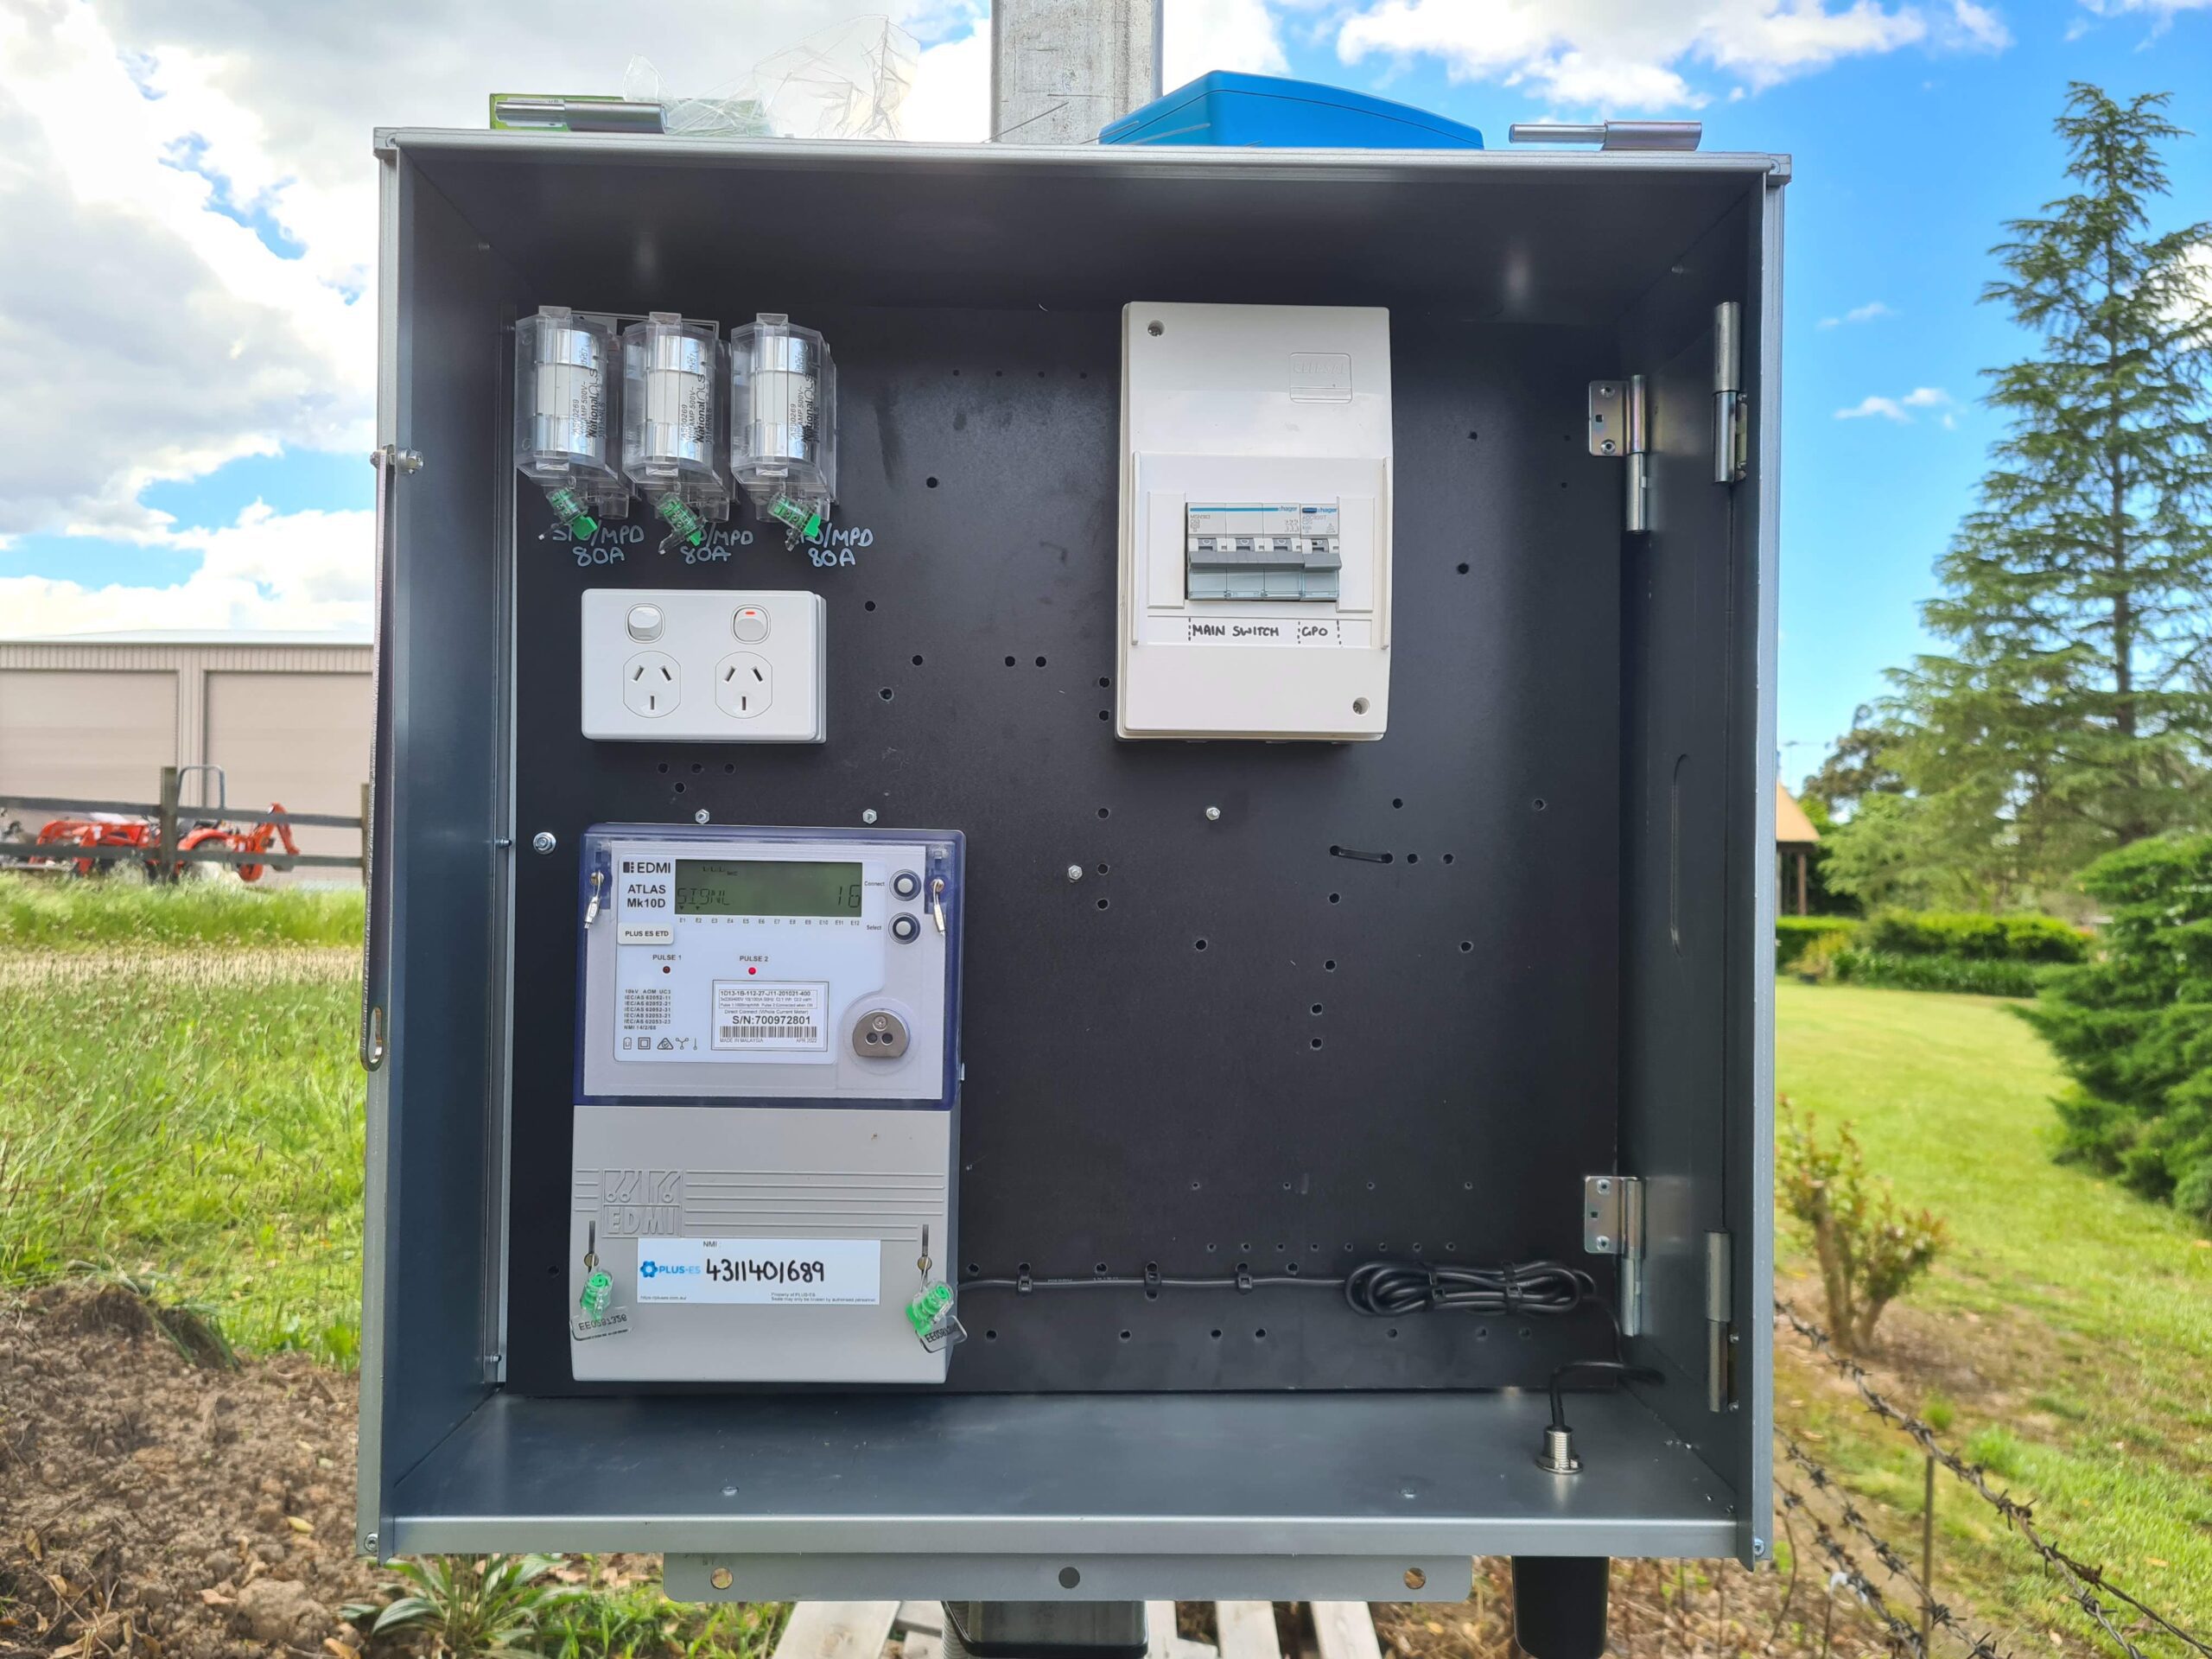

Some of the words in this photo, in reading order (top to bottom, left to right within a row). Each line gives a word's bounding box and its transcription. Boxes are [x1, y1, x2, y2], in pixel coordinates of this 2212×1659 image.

[587, 396, 598, 438] National
[696, 401, 705, 443] National
[572, 546, 625, 567] 80A
[680, 545, 732, 565] 80A
[808, 547, 856, 568] 80A
[1192, 624, 1225, 637] MAIN
[1232, 625, 1280, 638] SWITCH
[1301, 626, 1328, 637] GPO
[637, 862, 671, 874] EDMI
[627, 884, 666, 894] ATLAS
[837, 884, 861, 908] 16
[626, 898, 666, 908] Mk10D
[732, 1016, 810, 1025] S/N:700972801
[607, 1207, 677, 1236] EDMI
[705, 1258, 824, 1284] 4311401689
